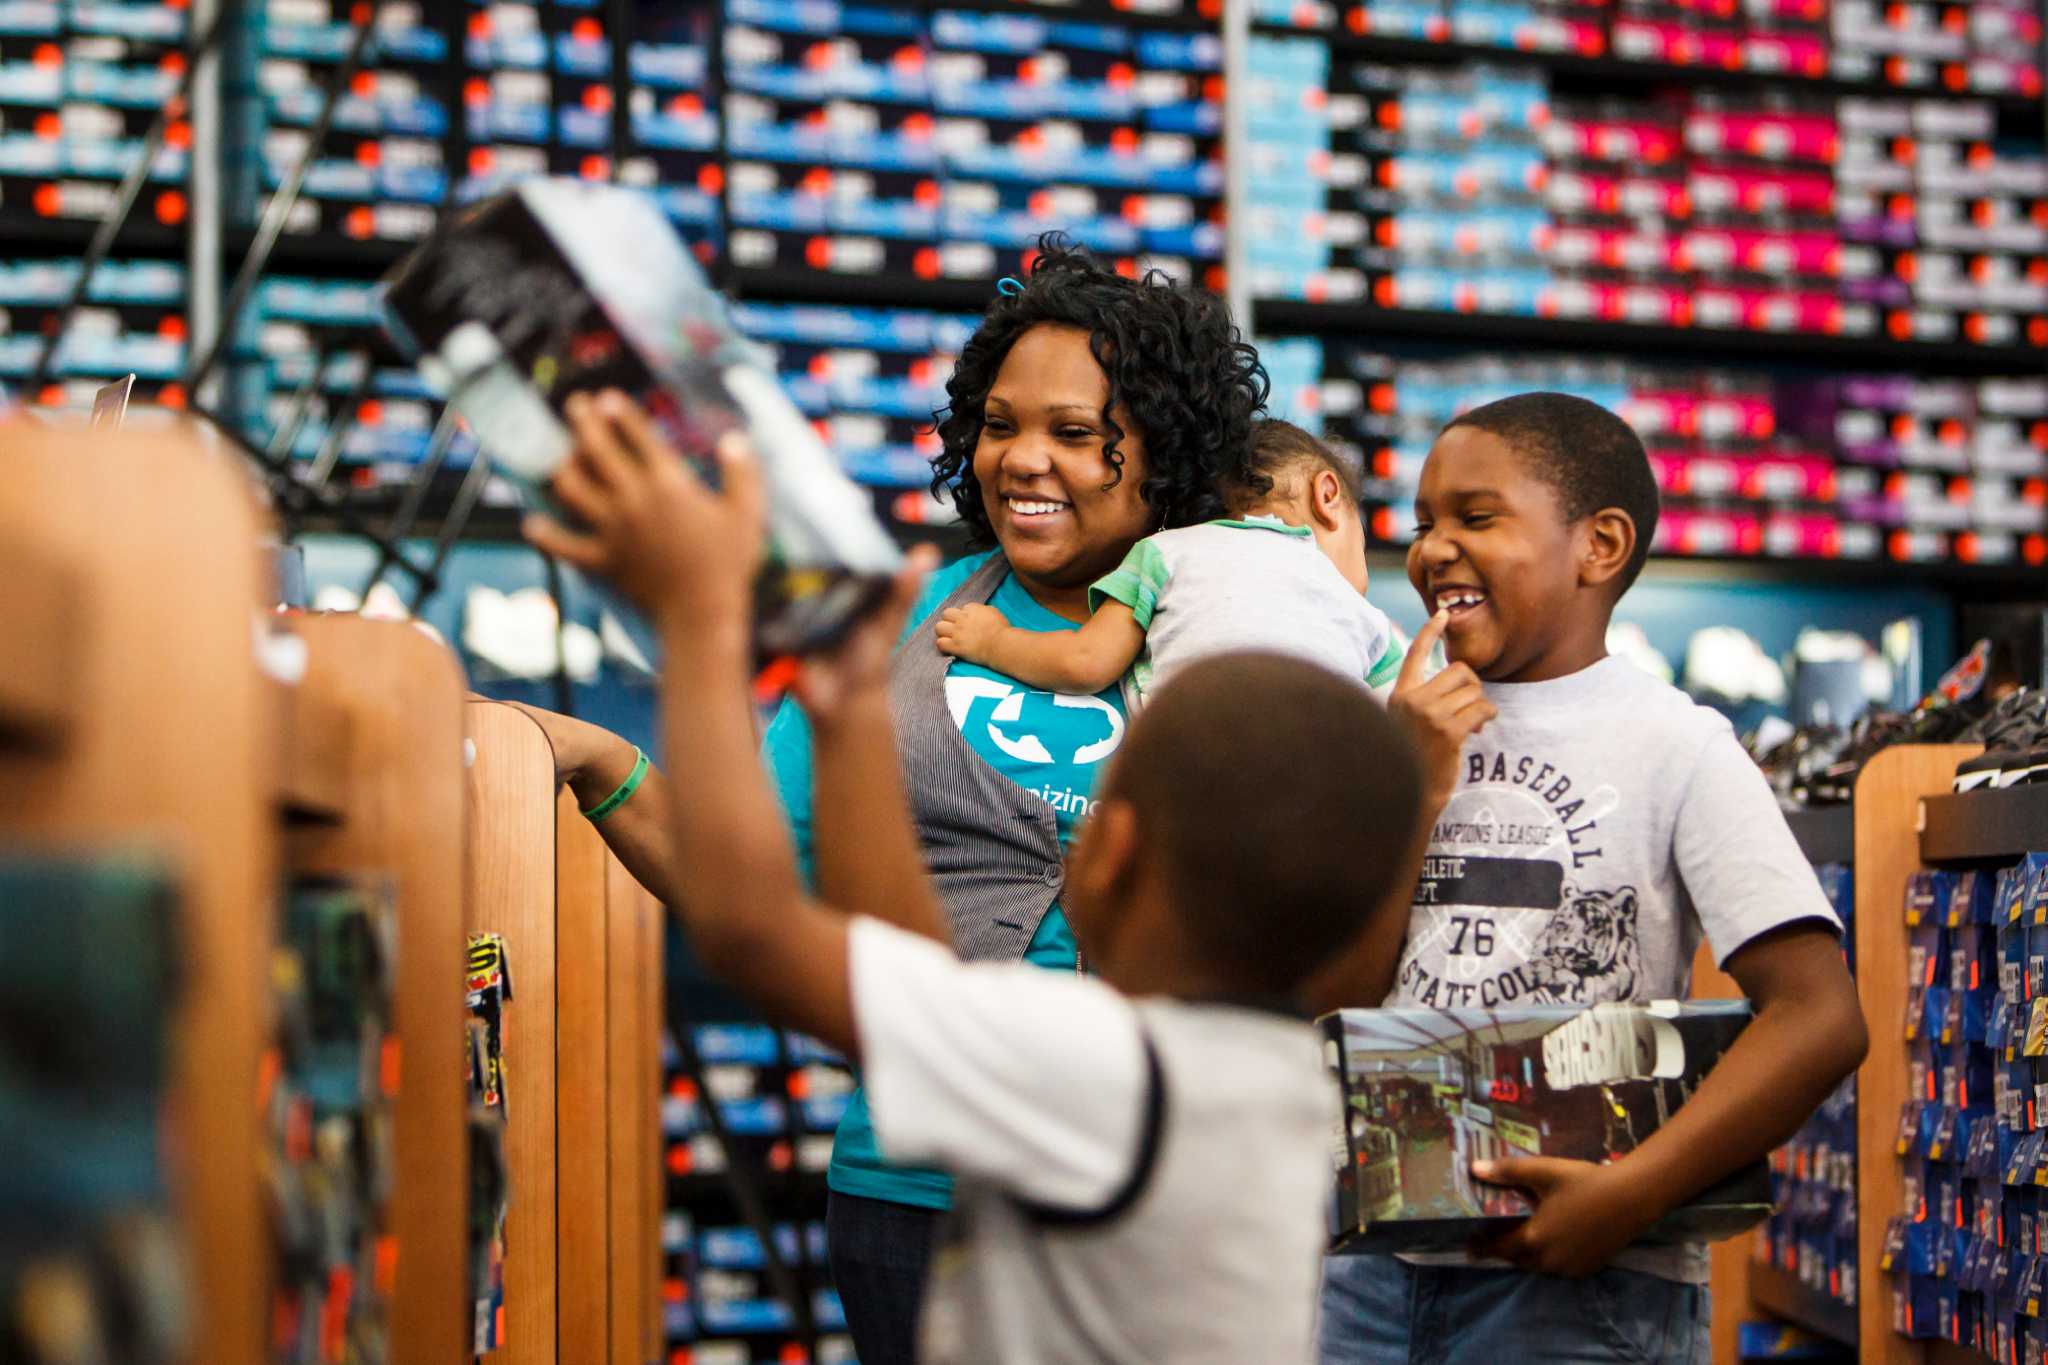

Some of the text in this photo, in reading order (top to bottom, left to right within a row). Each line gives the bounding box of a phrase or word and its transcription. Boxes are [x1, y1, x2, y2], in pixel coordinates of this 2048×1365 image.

[1467, 751, 1603, 869] BASEBALL
[1432, 822, 1554, 846] AMPIONS LEAGUE
[1421, 857, 1466, 879] HLETIC
[1447, 916, 1496, 957] 76
